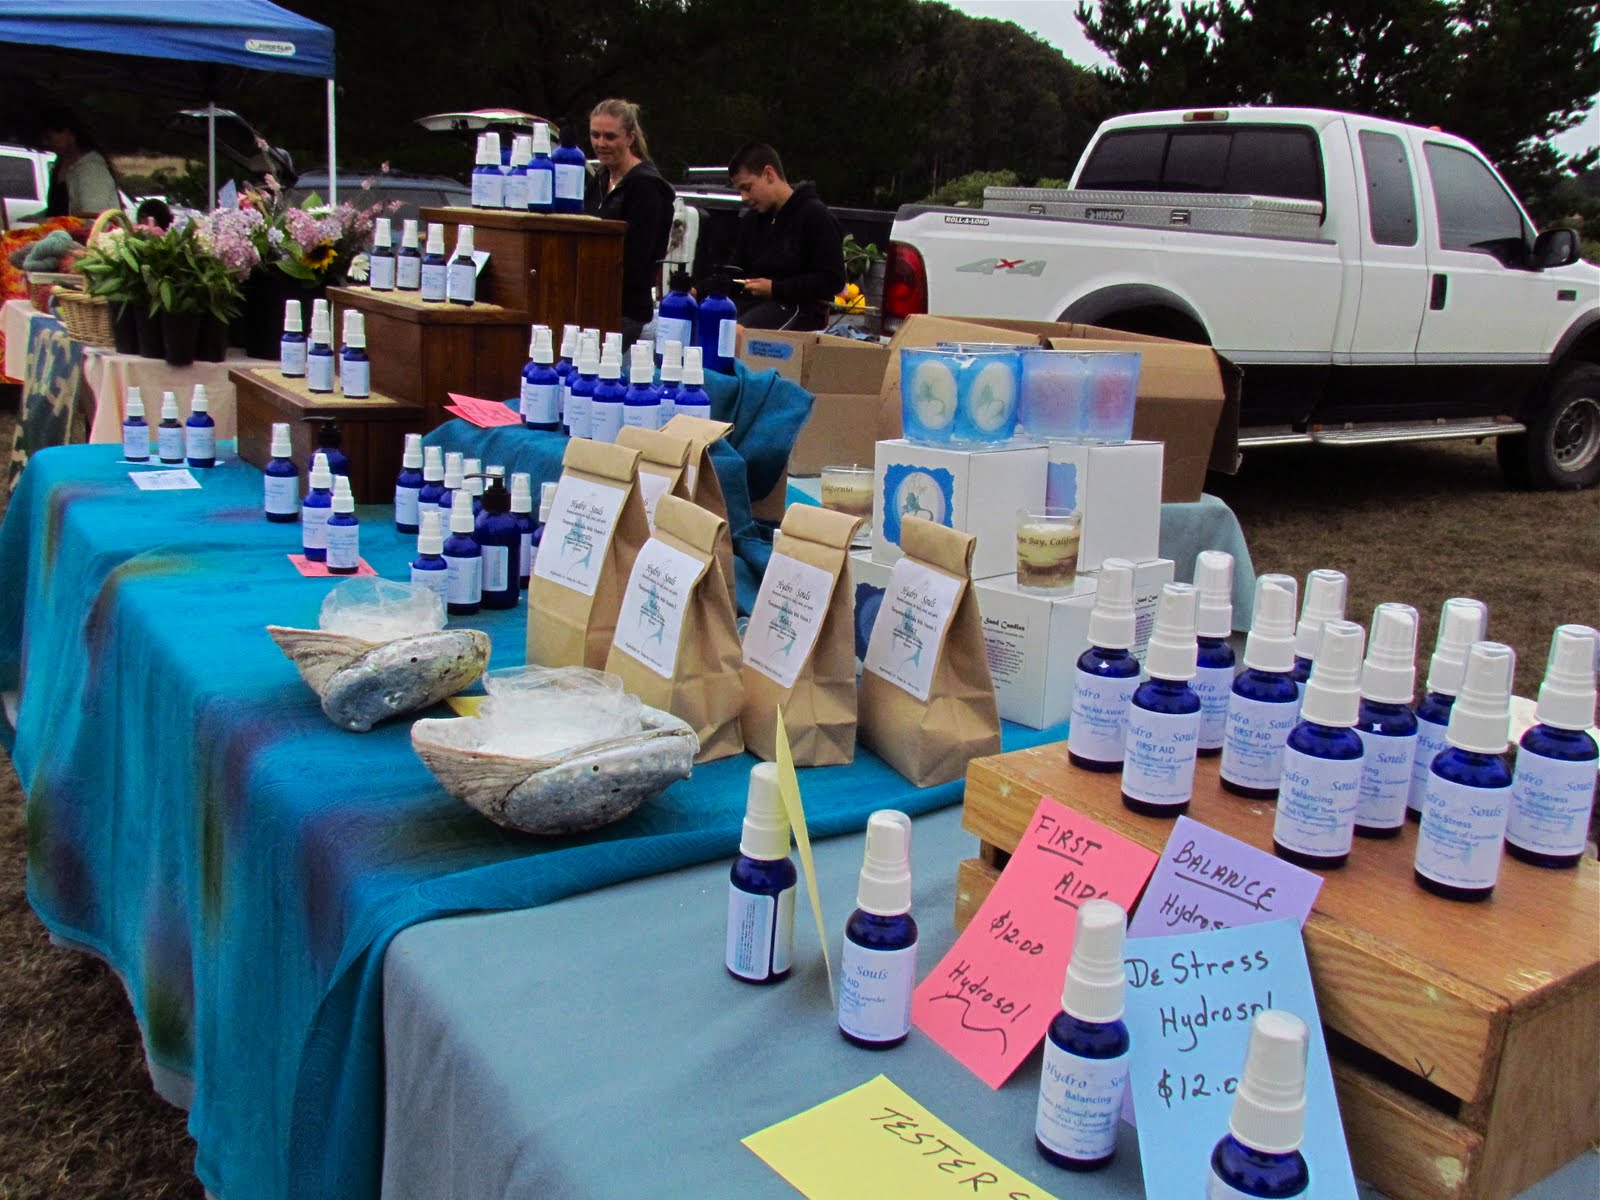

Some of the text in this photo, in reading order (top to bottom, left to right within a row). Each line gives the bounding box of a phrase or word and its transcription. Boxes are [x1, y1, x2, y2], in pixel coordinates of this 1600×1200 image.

[945, 216, 989, 225] ROLL-A-LONG
[1096, 210, 1124, 220] HUSKY
[901, 586, 918, 599] Hydro
[921, 596, 937, 607] Souls
[984, 617, 1025, 631] Sand Candles
[1233, 726, 1271, 741] FIRST AID
[1136, 740, 1176, 754] FIRST AID
[1418, 734, 1448, 752] Hydr
[1377, 752, 1408, 764] Souls
[1331, 778, 1358, 792] Souls
[1291, 787, 1334, 806] Balancing
[1524, 787, 1568, 804] De-Stress
[1429, 808, 1472, 829] De-Stress
[1469, 803, 1503, 817] Souls
[1035, 814, 1102, 856] FIRST
[1172, 840, 1276, 912] BALANCE
[990, 910, 1044, 955] $12.00
[856, 965, 889, 981] Souls
[1171, 950, 1269, 984] Stress
[945, 960, 1031, 1023] Hydrosol
[1046, 1061, 1087, 1089] Hydro
[1158, 1068, 1239, 1108] $12.0
[1065, 1089, 1112, 1105] Balancing
